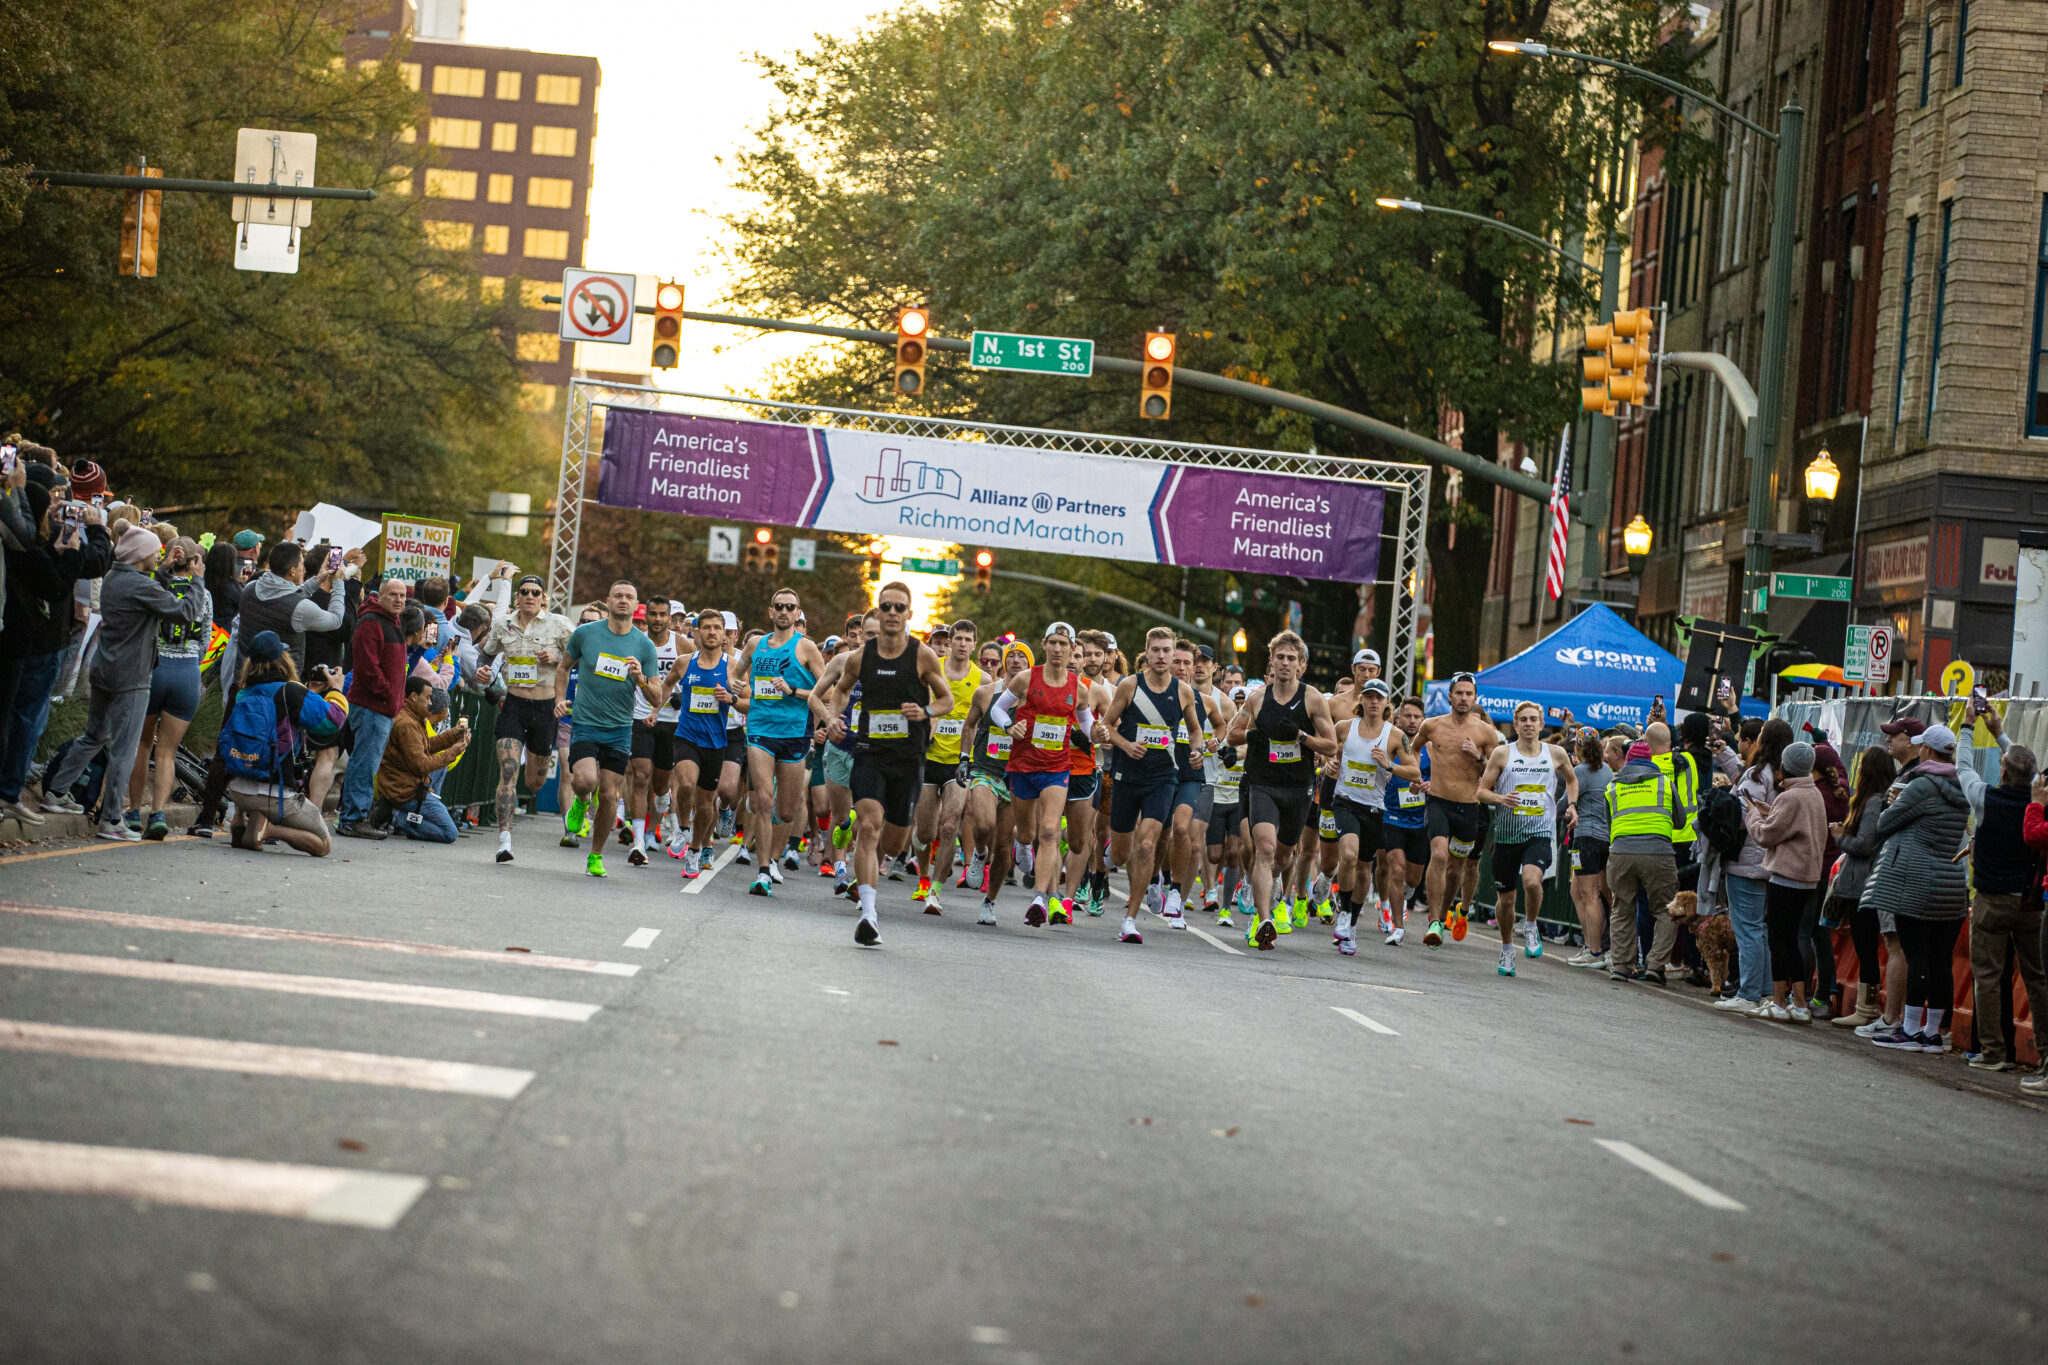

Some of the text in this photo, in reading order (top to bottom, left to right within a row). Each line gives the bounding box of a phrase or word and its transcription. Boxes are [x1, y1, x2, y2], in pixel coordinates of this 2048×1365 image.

[983, 336, 1081, 361] N. 1st St
[978, 354, 1001, 365] 300
[1061, 361, 1085, 372] 200
[653, 427, 749, 455] America's
[648, 452, 750, 481] Friendliest
[651, 477, 742, 504] Marathon
[970, 488, 1127, 518] Allianz Partners
[1235, 487, 1330, 514] America's
[1230, 511, 1333, 539] Friendliest
[393, 525, 451, 543] UR NOT
[386, 538, 451, 558] SWEATING
[1233, 536, 1324, 564] Marathon
[411, 555, 428, 569] UR
[1777, 578, 1847, 596] N 1st St
[1831, 589, 1847, 598] 200
[755, 657, 779, 665] FLEET
[1582, 650, 1656, 667] SPORTS
[603, 665, 620, 675] 4471
[756, 664, 776, 672] FEET
[1596, 661, 1657, 673] BACKERS
[514, 671, 530, 679] 2935
[1602, 704, 1641, 717] SPORTS
[1607, 714, 1641, 722] BACKERS
[877, 723, 899, 732] 1256
[939, 726, 957, 734] 2106
[1040, 731, 1058, 740] 3931
[1143, 736, 1161, 744] 2443
[1350, 776, 1368, 785] 2353
